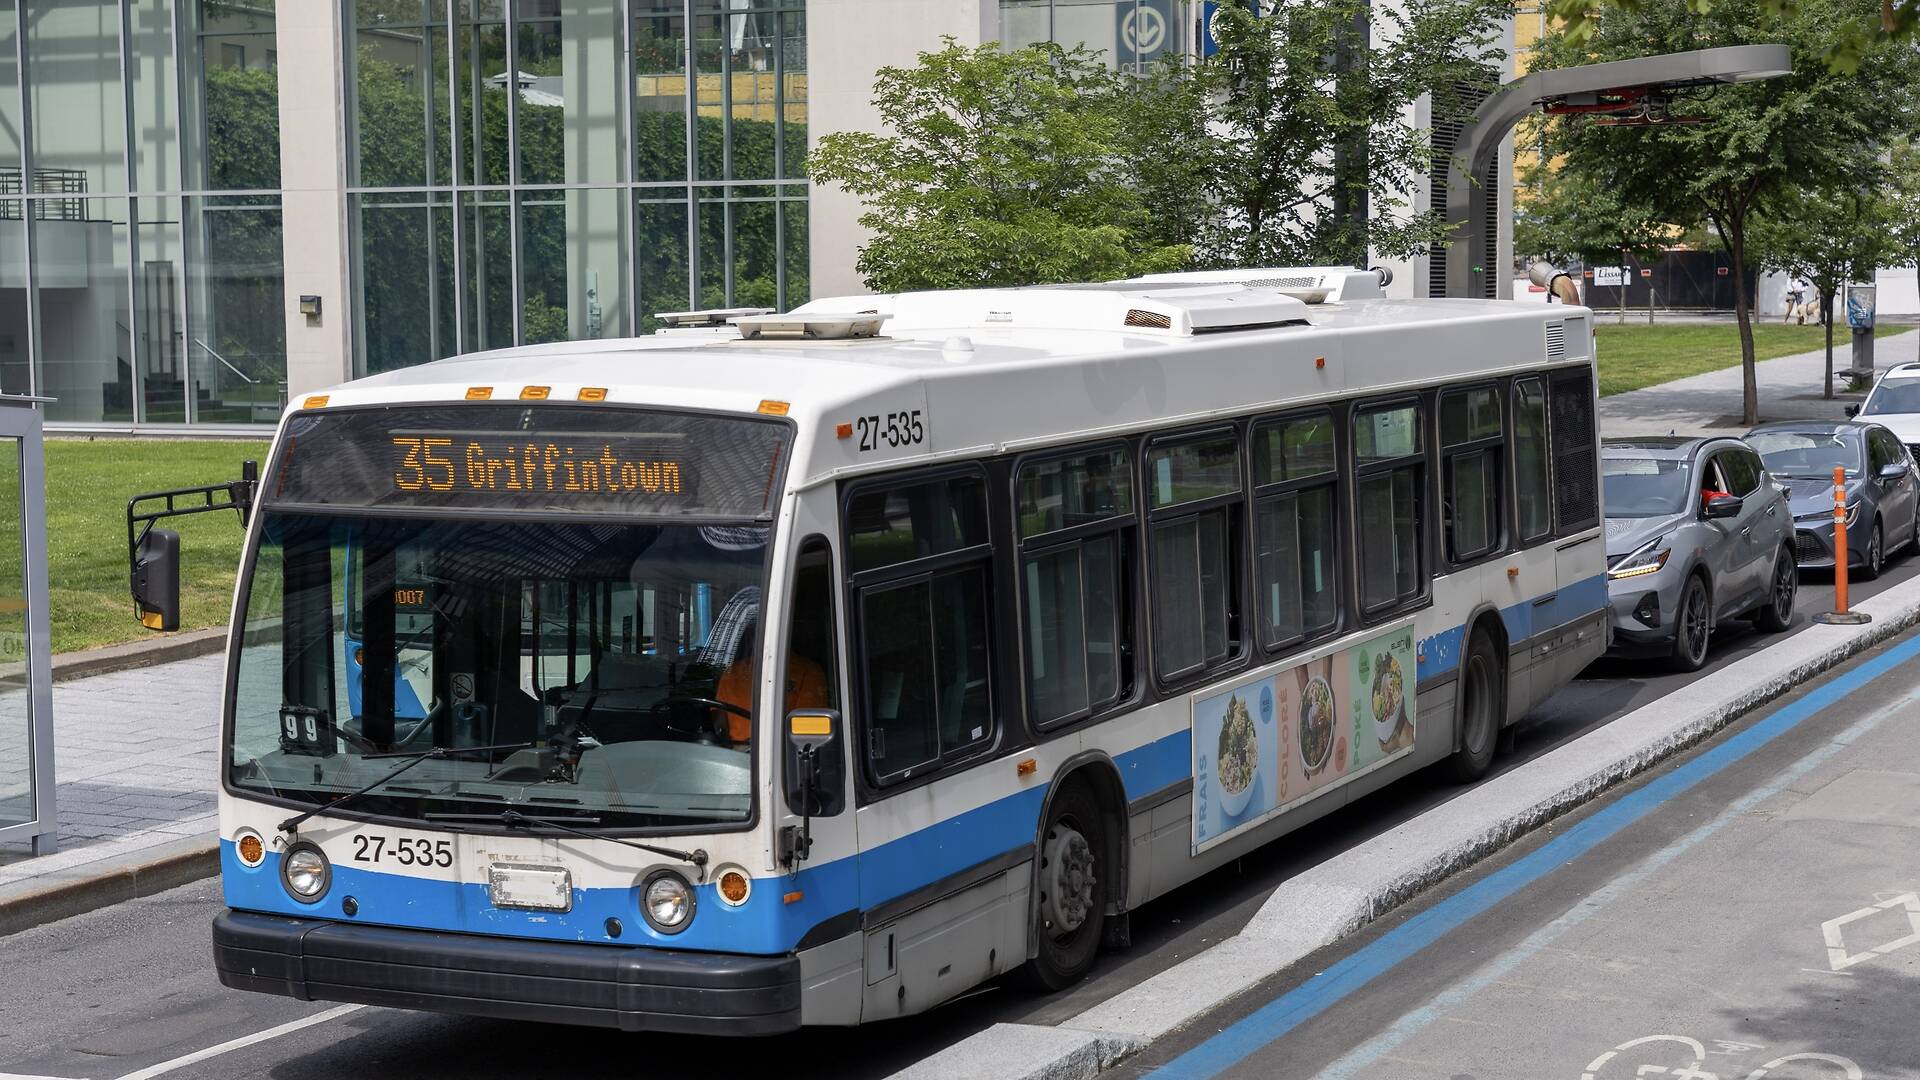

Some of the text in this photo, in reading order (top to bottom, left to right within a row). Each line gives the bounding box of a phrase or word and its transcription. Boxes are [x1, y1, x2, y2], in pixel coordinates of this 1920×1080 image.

[857, 410, 923, 451] 27-535
[393, 438, 680, 493] 35 Griffintown
[395, 590, 424, 605] 007
[1199, 754, 1208, 838] FRAIS
[353, 834, 453, 867] 27-535
